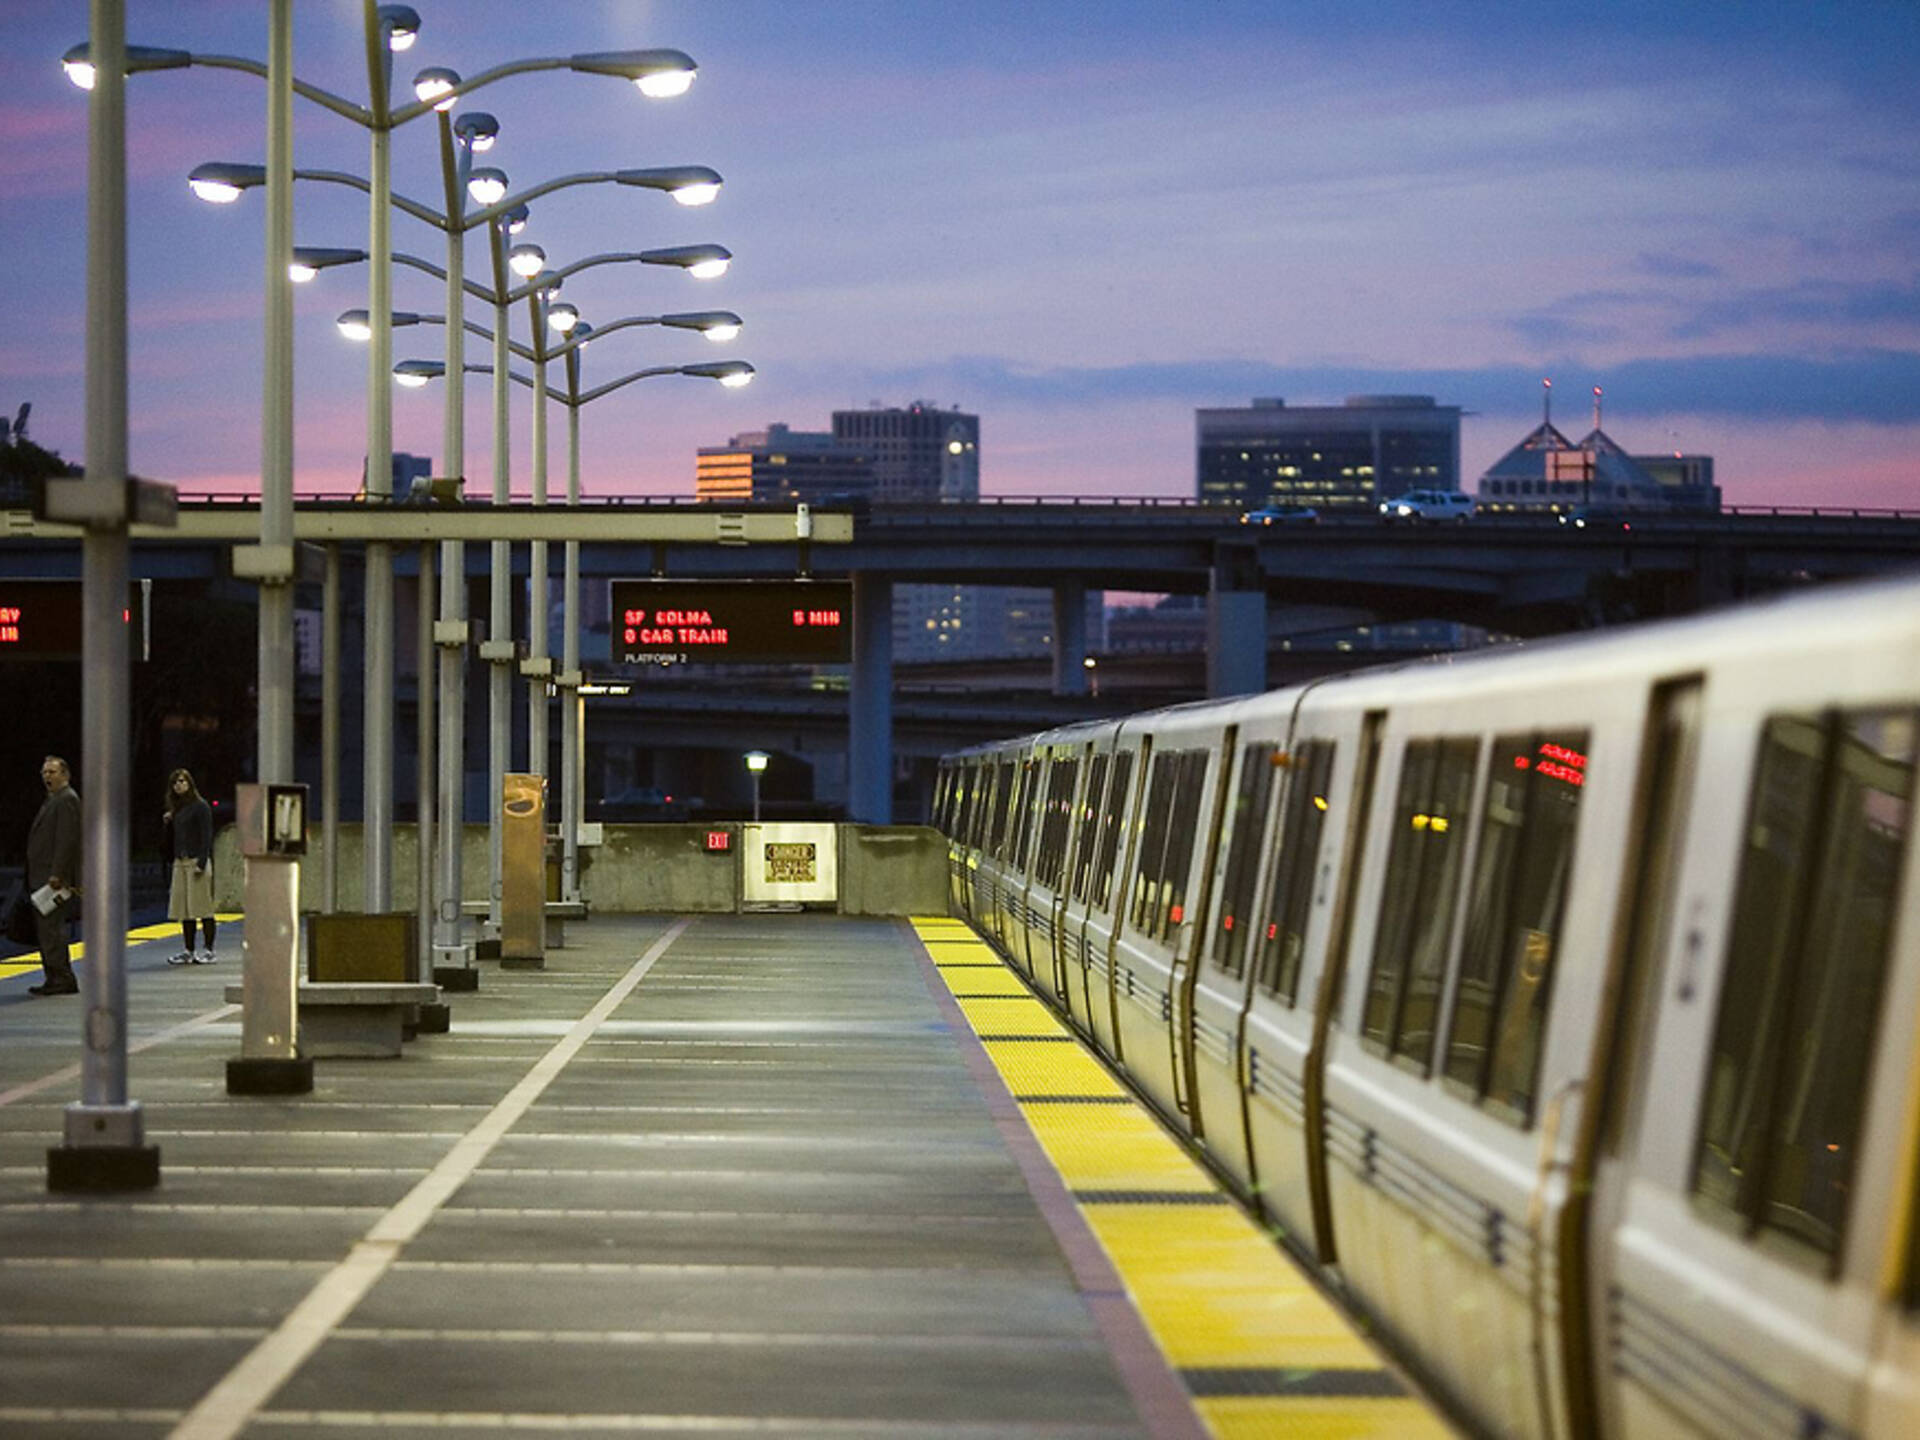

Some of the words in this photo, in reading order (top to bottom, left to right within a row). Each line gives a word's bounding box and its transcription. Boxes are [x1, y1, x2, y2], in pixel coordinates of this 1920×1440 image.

[655, 610, 712, 626] COLMA
[809, 609, 840, 626] MIN
[640, 628, 673, 644] CAR
[678, 629, 728, 644] TRAIN
[625, 653, 677, 663] PLATFORM
[708, 833, 728, 848] EXIT
